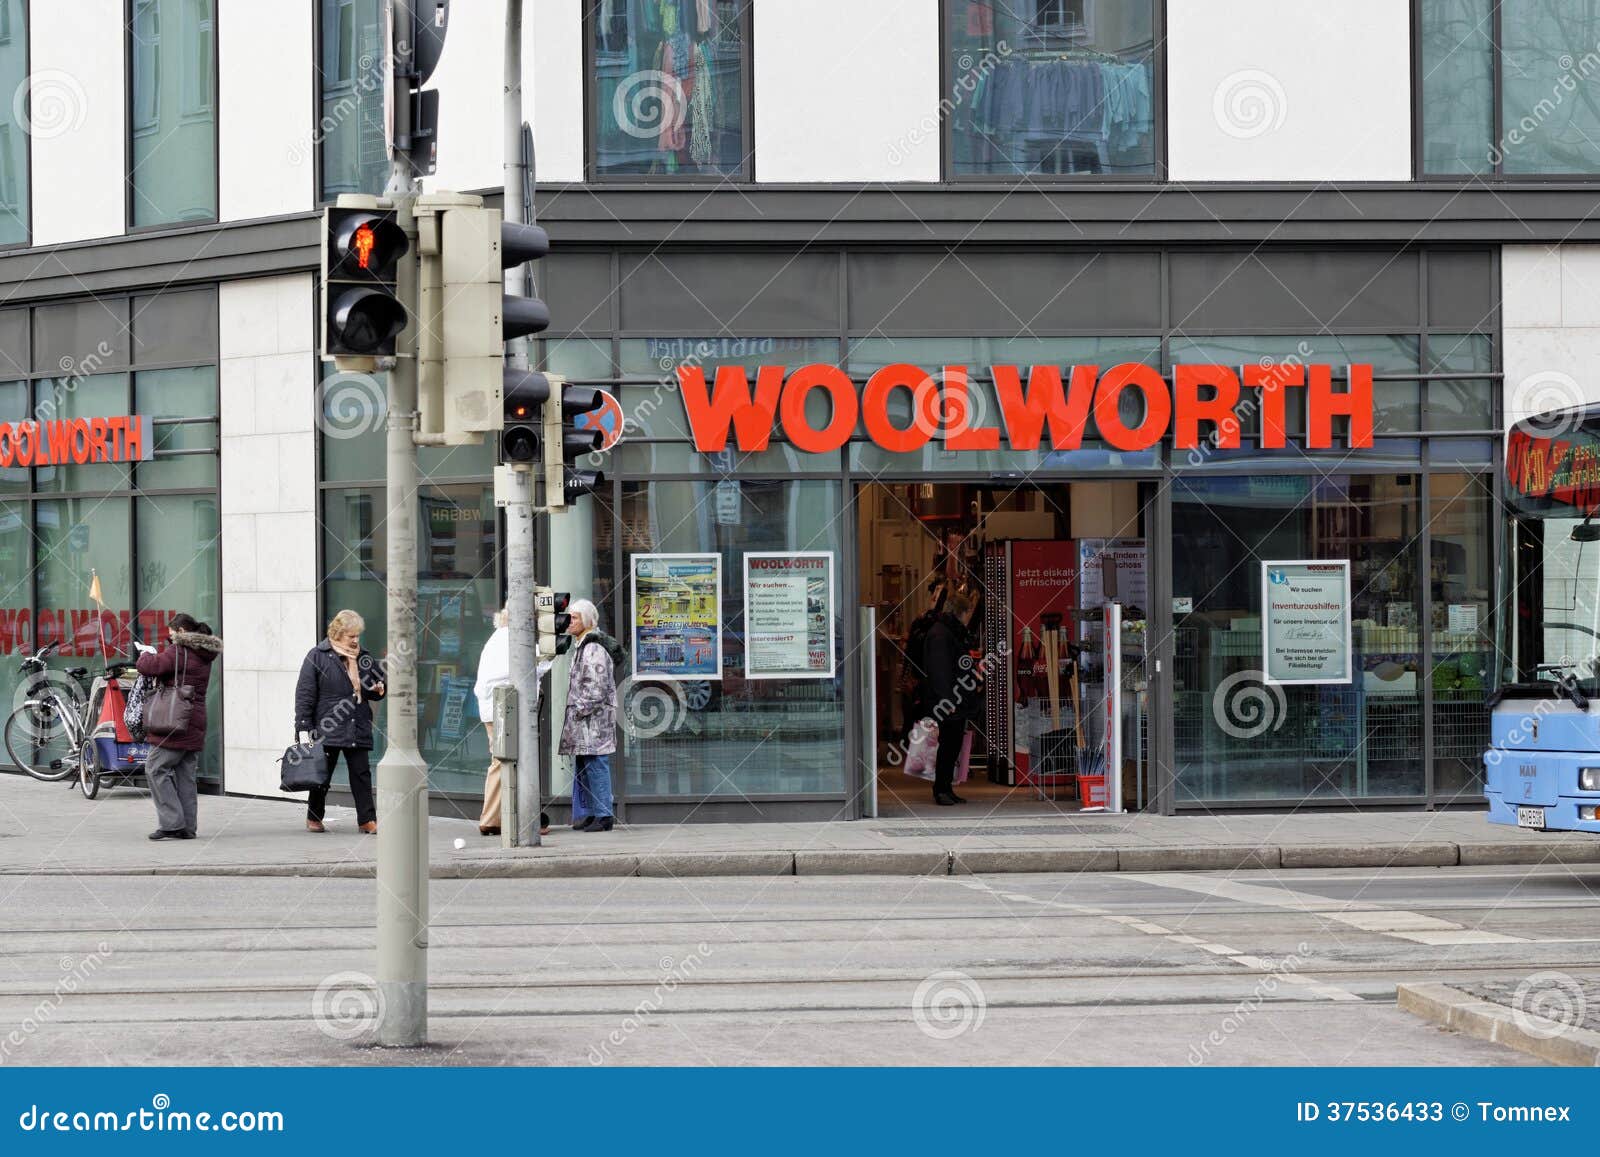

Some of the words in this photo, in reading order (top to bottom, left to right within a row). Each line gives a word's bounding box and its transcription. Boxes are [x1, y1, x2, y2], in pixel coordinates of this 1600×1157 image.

[677, 363, 1374, 453] WOOLWORTH
[1113, 551, 1138, 559] finden
[750, 559, 824, 569] WOOLWORTH
[1016, 569, 1041, 577] Jetzt
[1043, 568, 1075, 577] eiskalt
[1019, 578, 1071, 587] erfrischen!
[1272, 602, 1340, 610] Inventuraushilfen
[1519, 765, 1537, 777] MAN
